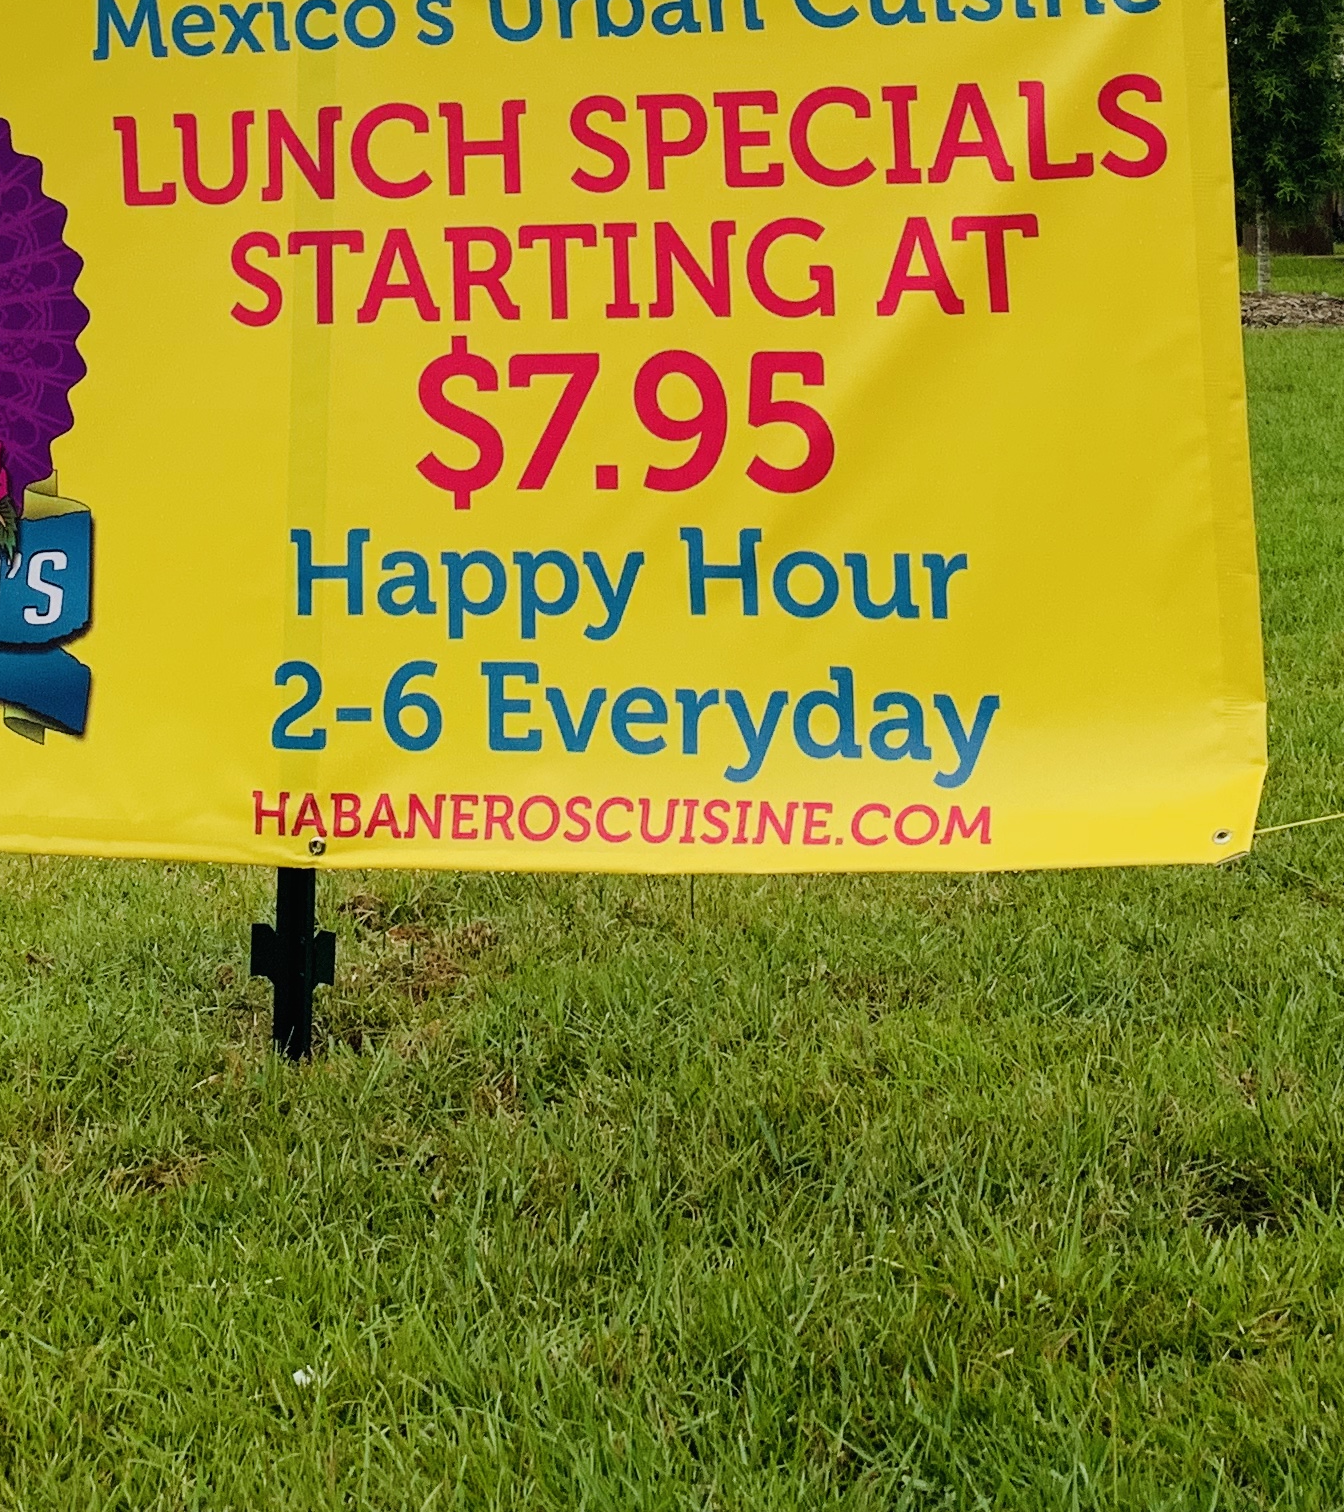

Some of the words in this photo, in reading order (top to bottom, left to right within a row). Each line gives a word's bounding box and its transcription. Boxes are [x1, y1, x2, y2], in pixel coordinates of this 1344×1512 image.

[114, 100, 526, 206] LUNCH
[569, 73, 1168, 193] SPECIALS
[231, 217, 836, 327] STARTING
[876, 214, 1039, 316] AT
[417, 335, 836, 510] $7.95
[291, 528, 645, 640] Happy
[680, 527, 968, 620] Hour
[272, 661, 442, 752] 2-6
[482, 662, 1000, 789] Everyday
[253, 790, 993, 847] HABANEROSCUISINE.COM
